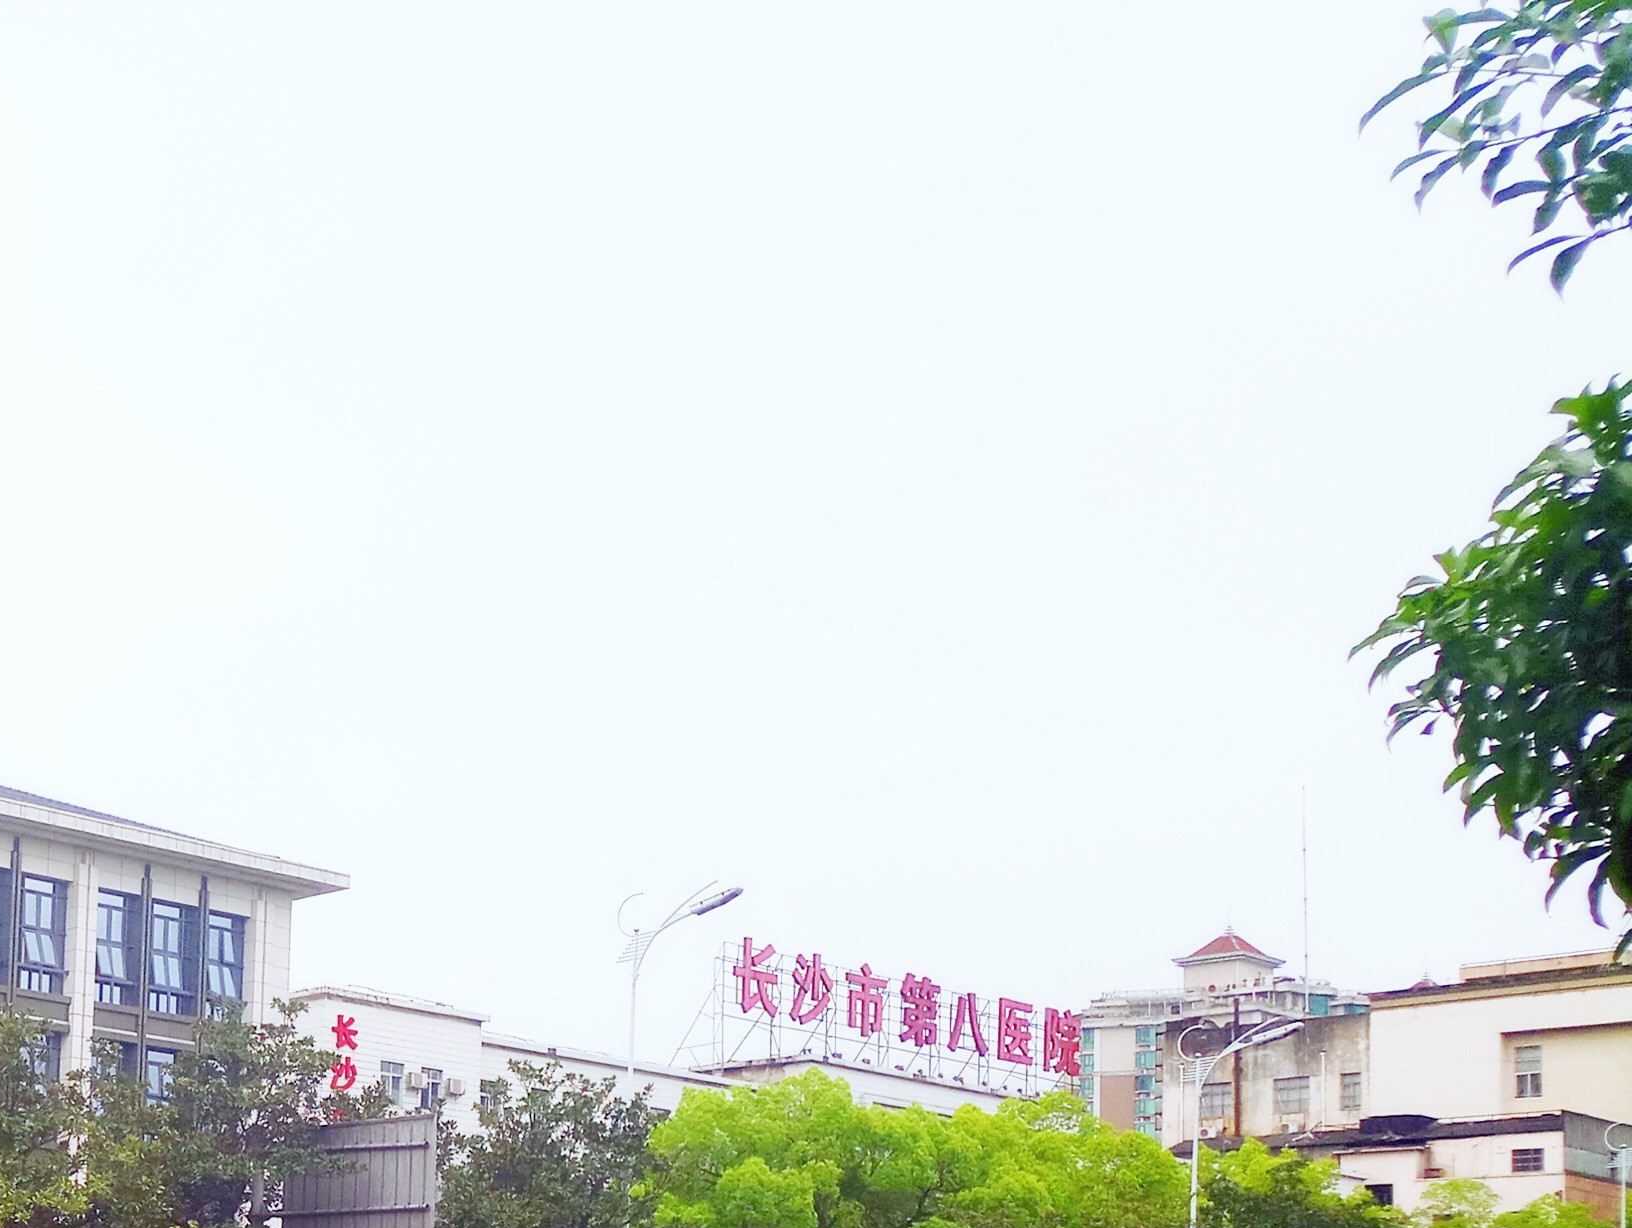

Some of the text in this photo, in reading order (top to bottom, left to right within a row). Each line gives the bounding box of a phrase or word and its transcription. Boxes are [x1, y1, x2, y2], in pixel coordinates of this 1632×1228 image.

[733, 937, 1081, 1076] 长沙市第八医院
